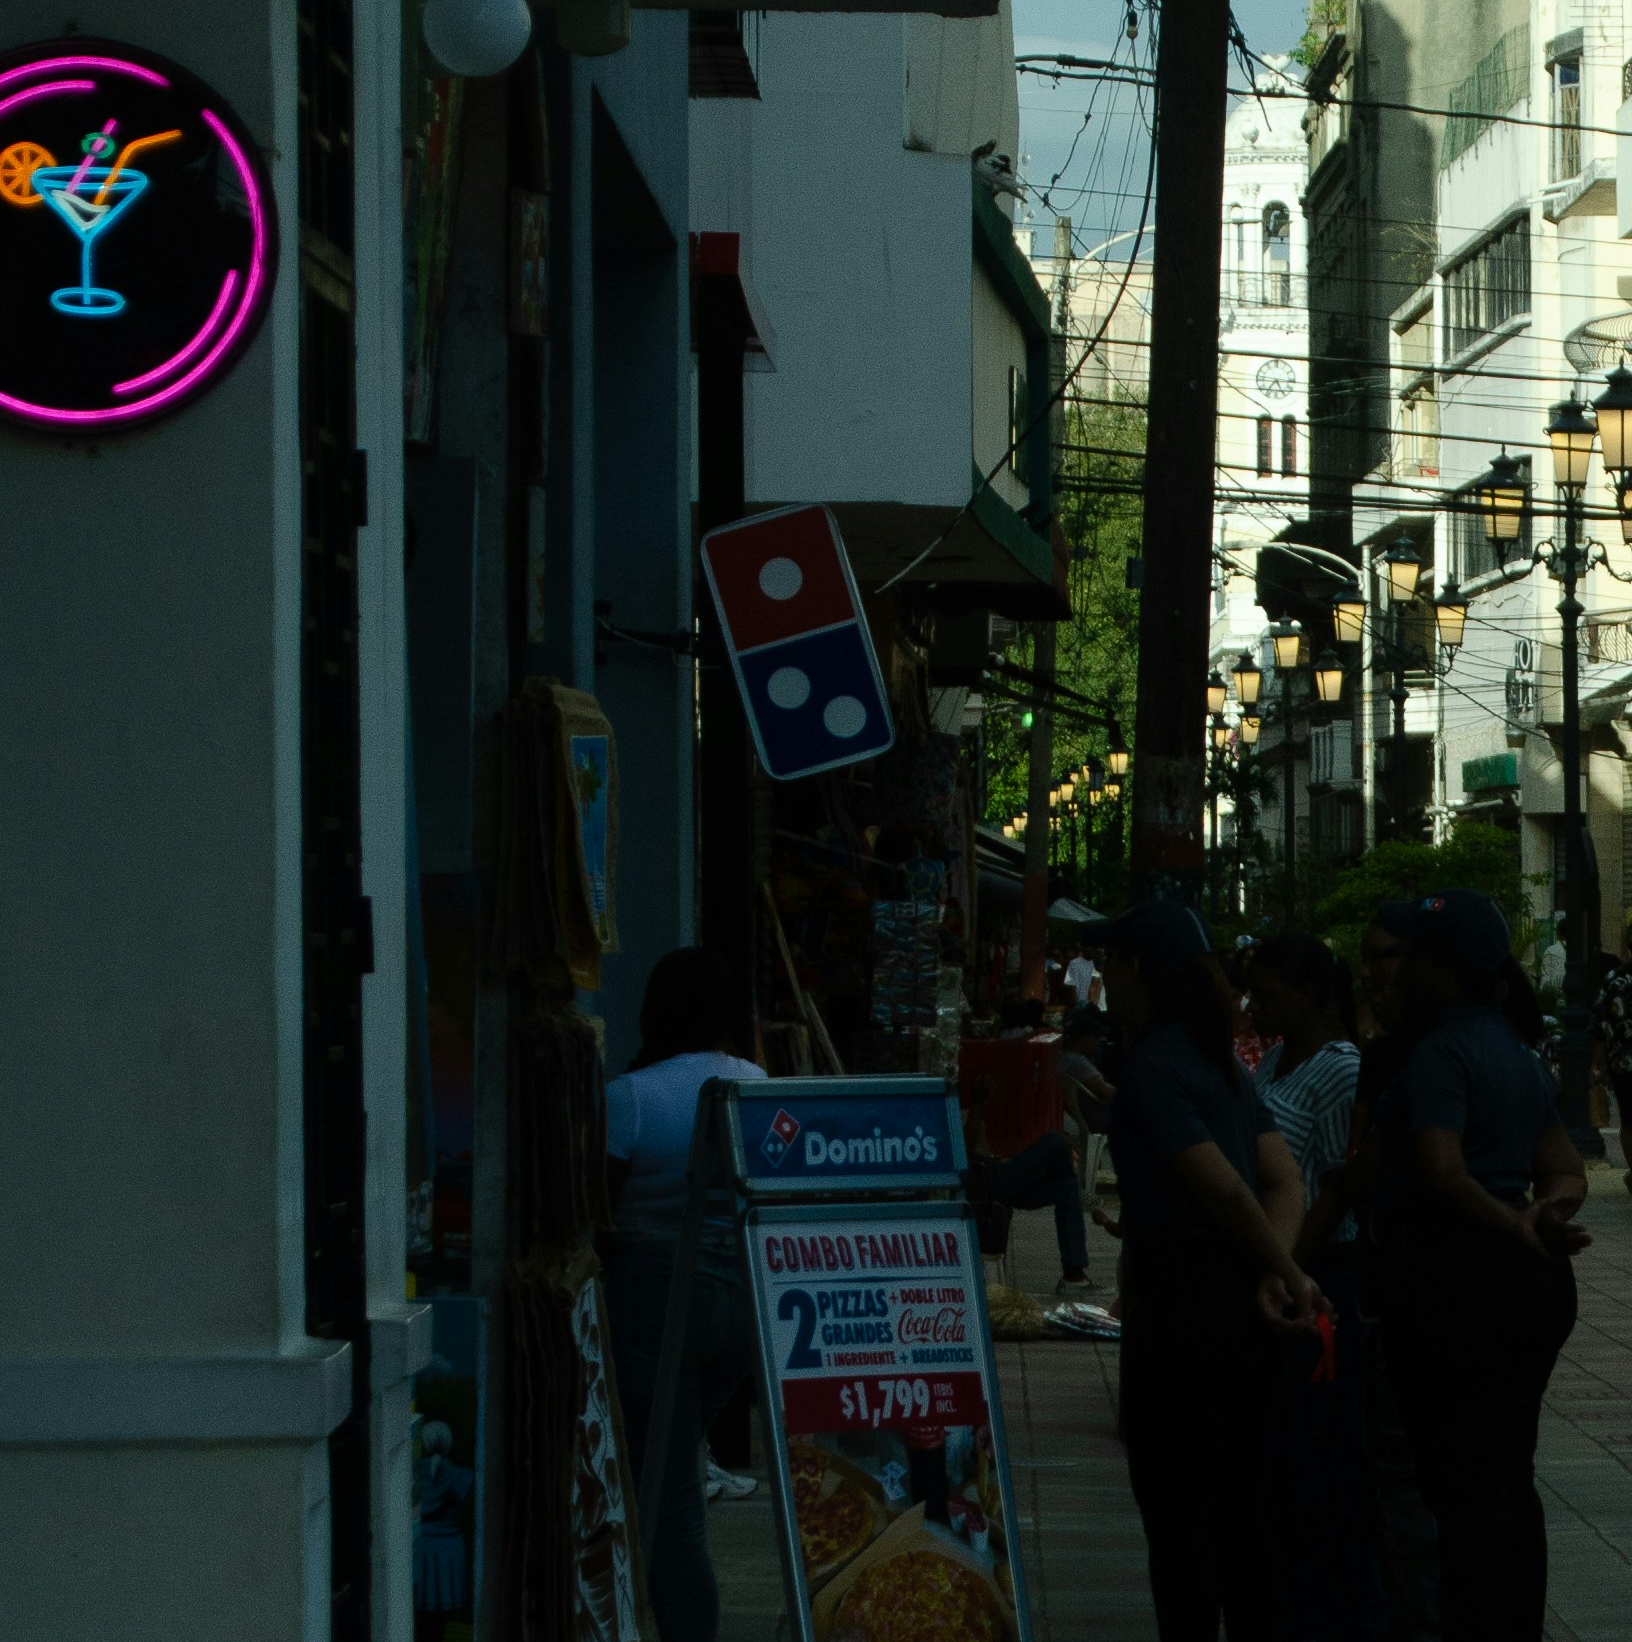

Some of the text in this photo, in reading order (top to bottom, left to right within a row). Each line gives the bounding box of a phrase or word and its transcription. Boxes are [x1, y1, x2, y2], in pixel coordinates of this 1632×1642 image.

[804, 1125, 939, 1166] Domino's
[765, 1232, 961, 1273] COMBO FAMILIAR
[816, 1289, 889, 1319] PIZZAS
[900, 1288, 934, 1304] DOBLE
[936, 1287, 965, 1303] LITRO
[778, 1288, 822, 1370] 2
[821, 1321, 893, 1345] GRANDES
[826, 1352, 832, 1367] 1
[833, 1350, 897, 1367] INGREDIENTE
[912, 1347, 974, 1364] BREADSTICKS
[839, 1379, 931, 1430] $1,799
